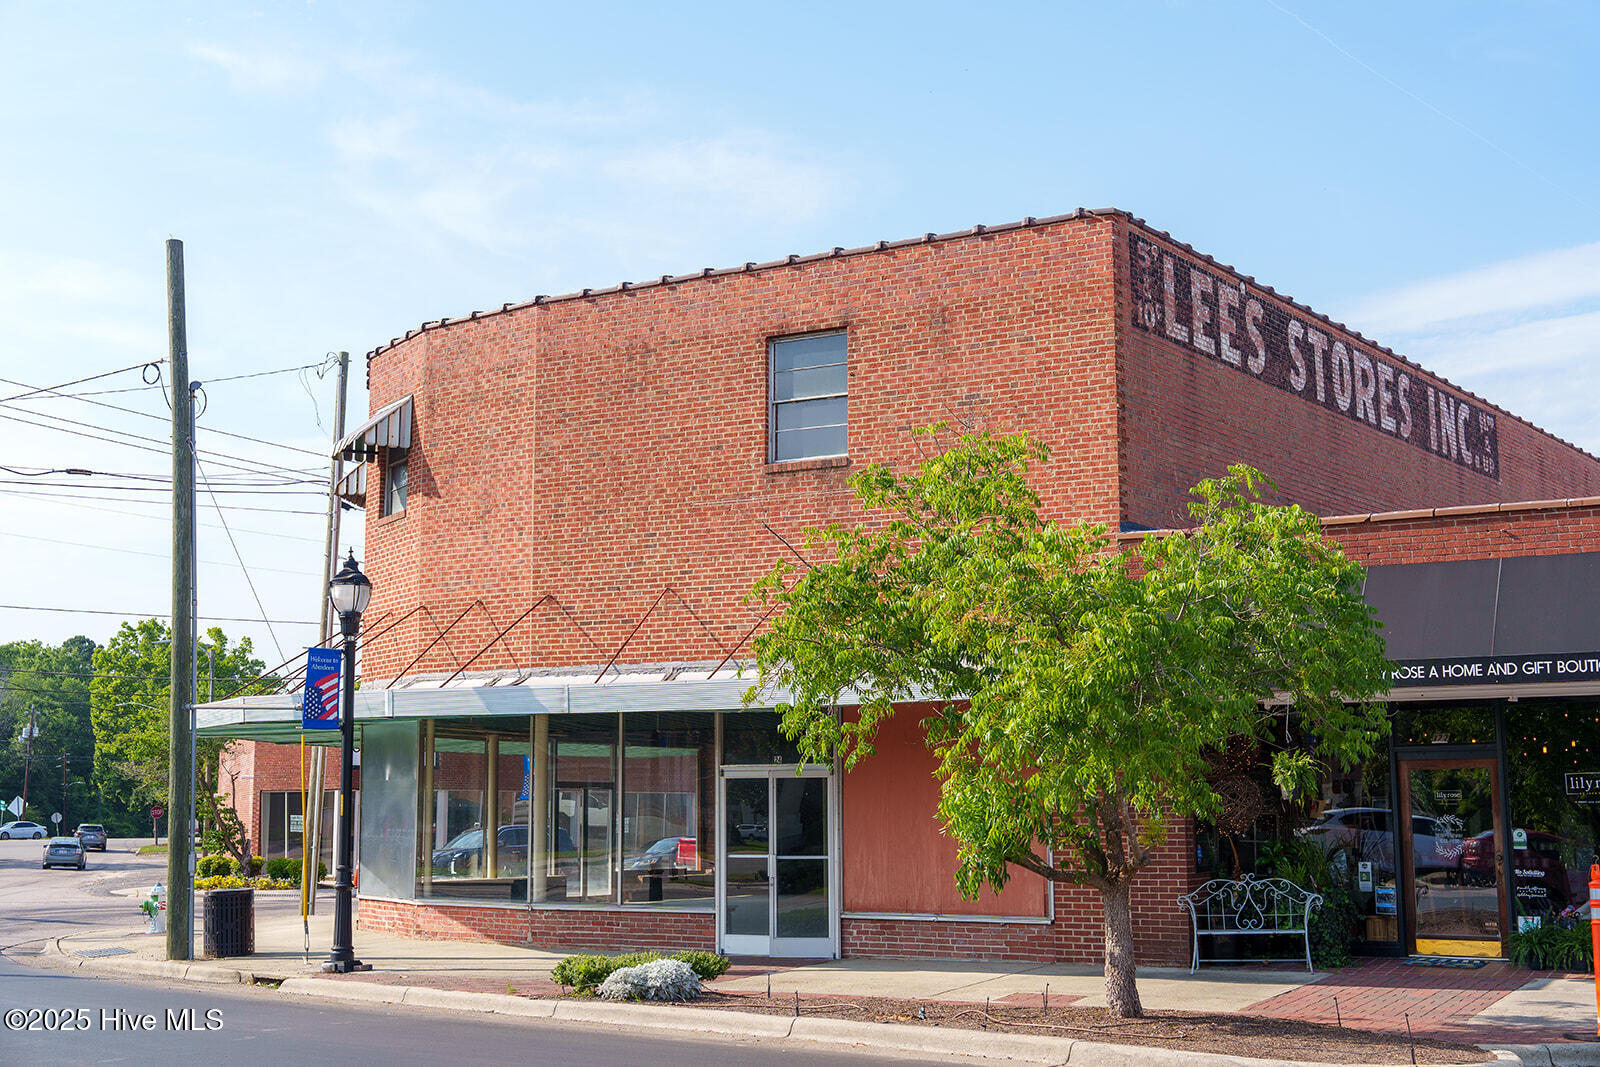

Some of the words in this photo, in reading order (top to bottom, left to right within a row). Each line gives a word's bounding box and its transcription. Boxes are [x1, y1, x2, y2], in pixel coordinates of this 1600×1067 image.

[1163, 255, 1266, 375] LEE'S
[1287, 319, 1412, 438] STORES
[1427, 386, 1480, 469] INC.
[1391, 665, 1425, 679] ROSE
[1428, 665, 1439, 678] A
[1442, 663, 1483, 677] HOME
[1487, 662, 1518, 676] AND
[1522, 661, 1553, 675] GIFT
[1557, 659, 1600, 673] BOUTI
[1570, 776, 1593, 792] lily
